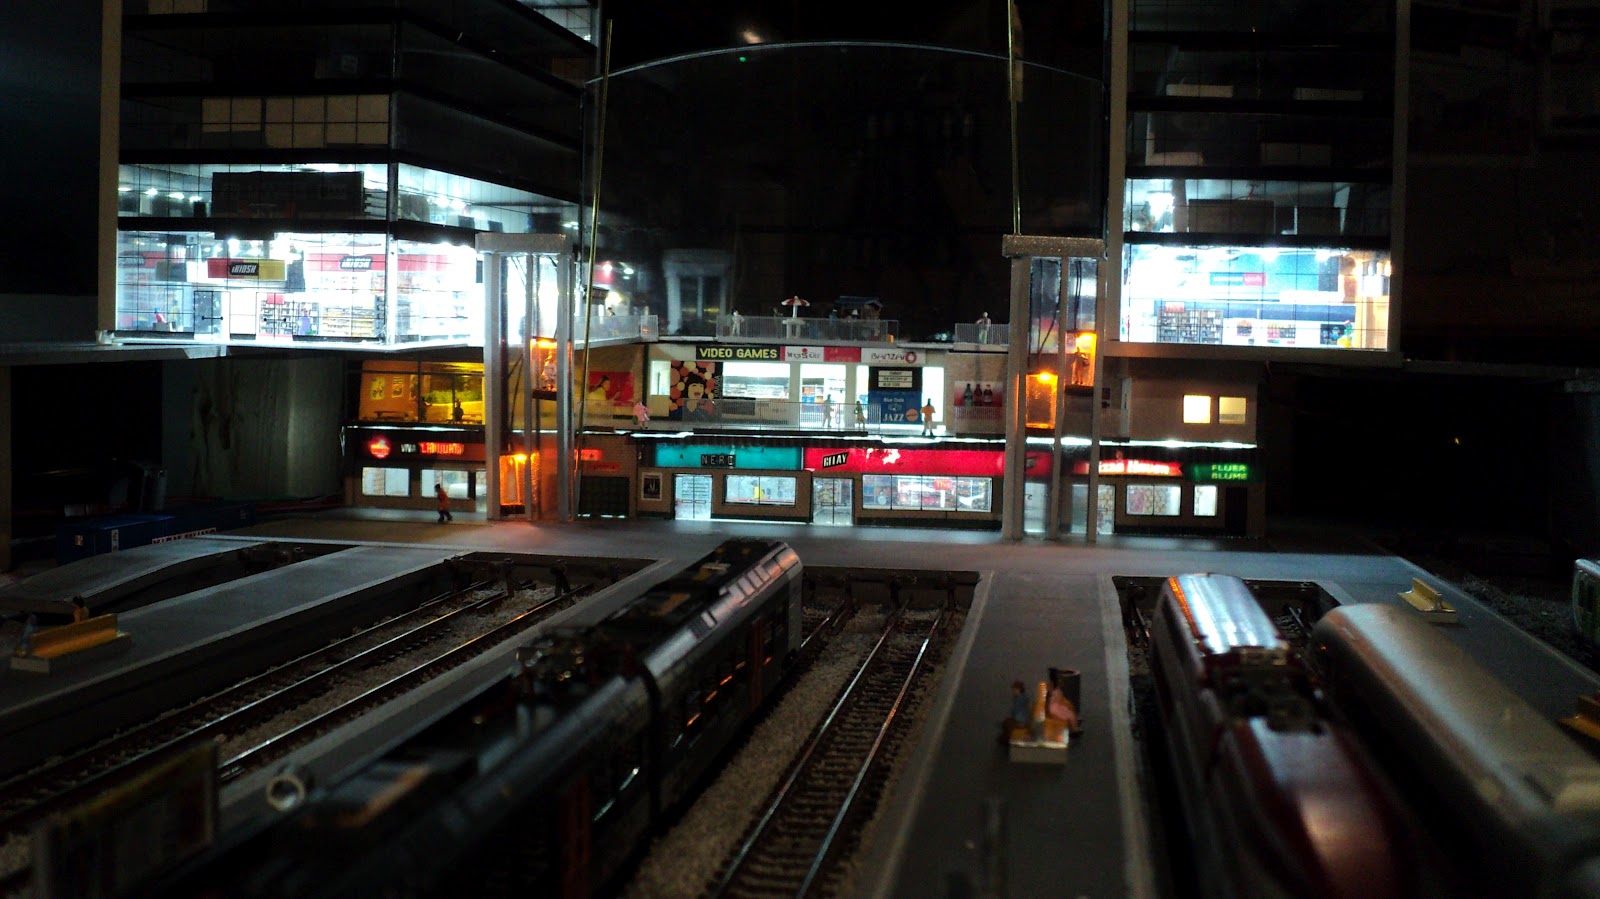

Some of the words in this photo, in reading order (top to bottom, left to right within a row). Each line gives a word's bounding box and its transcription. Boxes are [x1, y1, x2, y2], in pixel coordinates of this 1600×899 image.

[699, 348, 733, 358] VIDEO
[736, 348, 778, 359] GAMES
[882, 413, 905, 422] JAZZ
